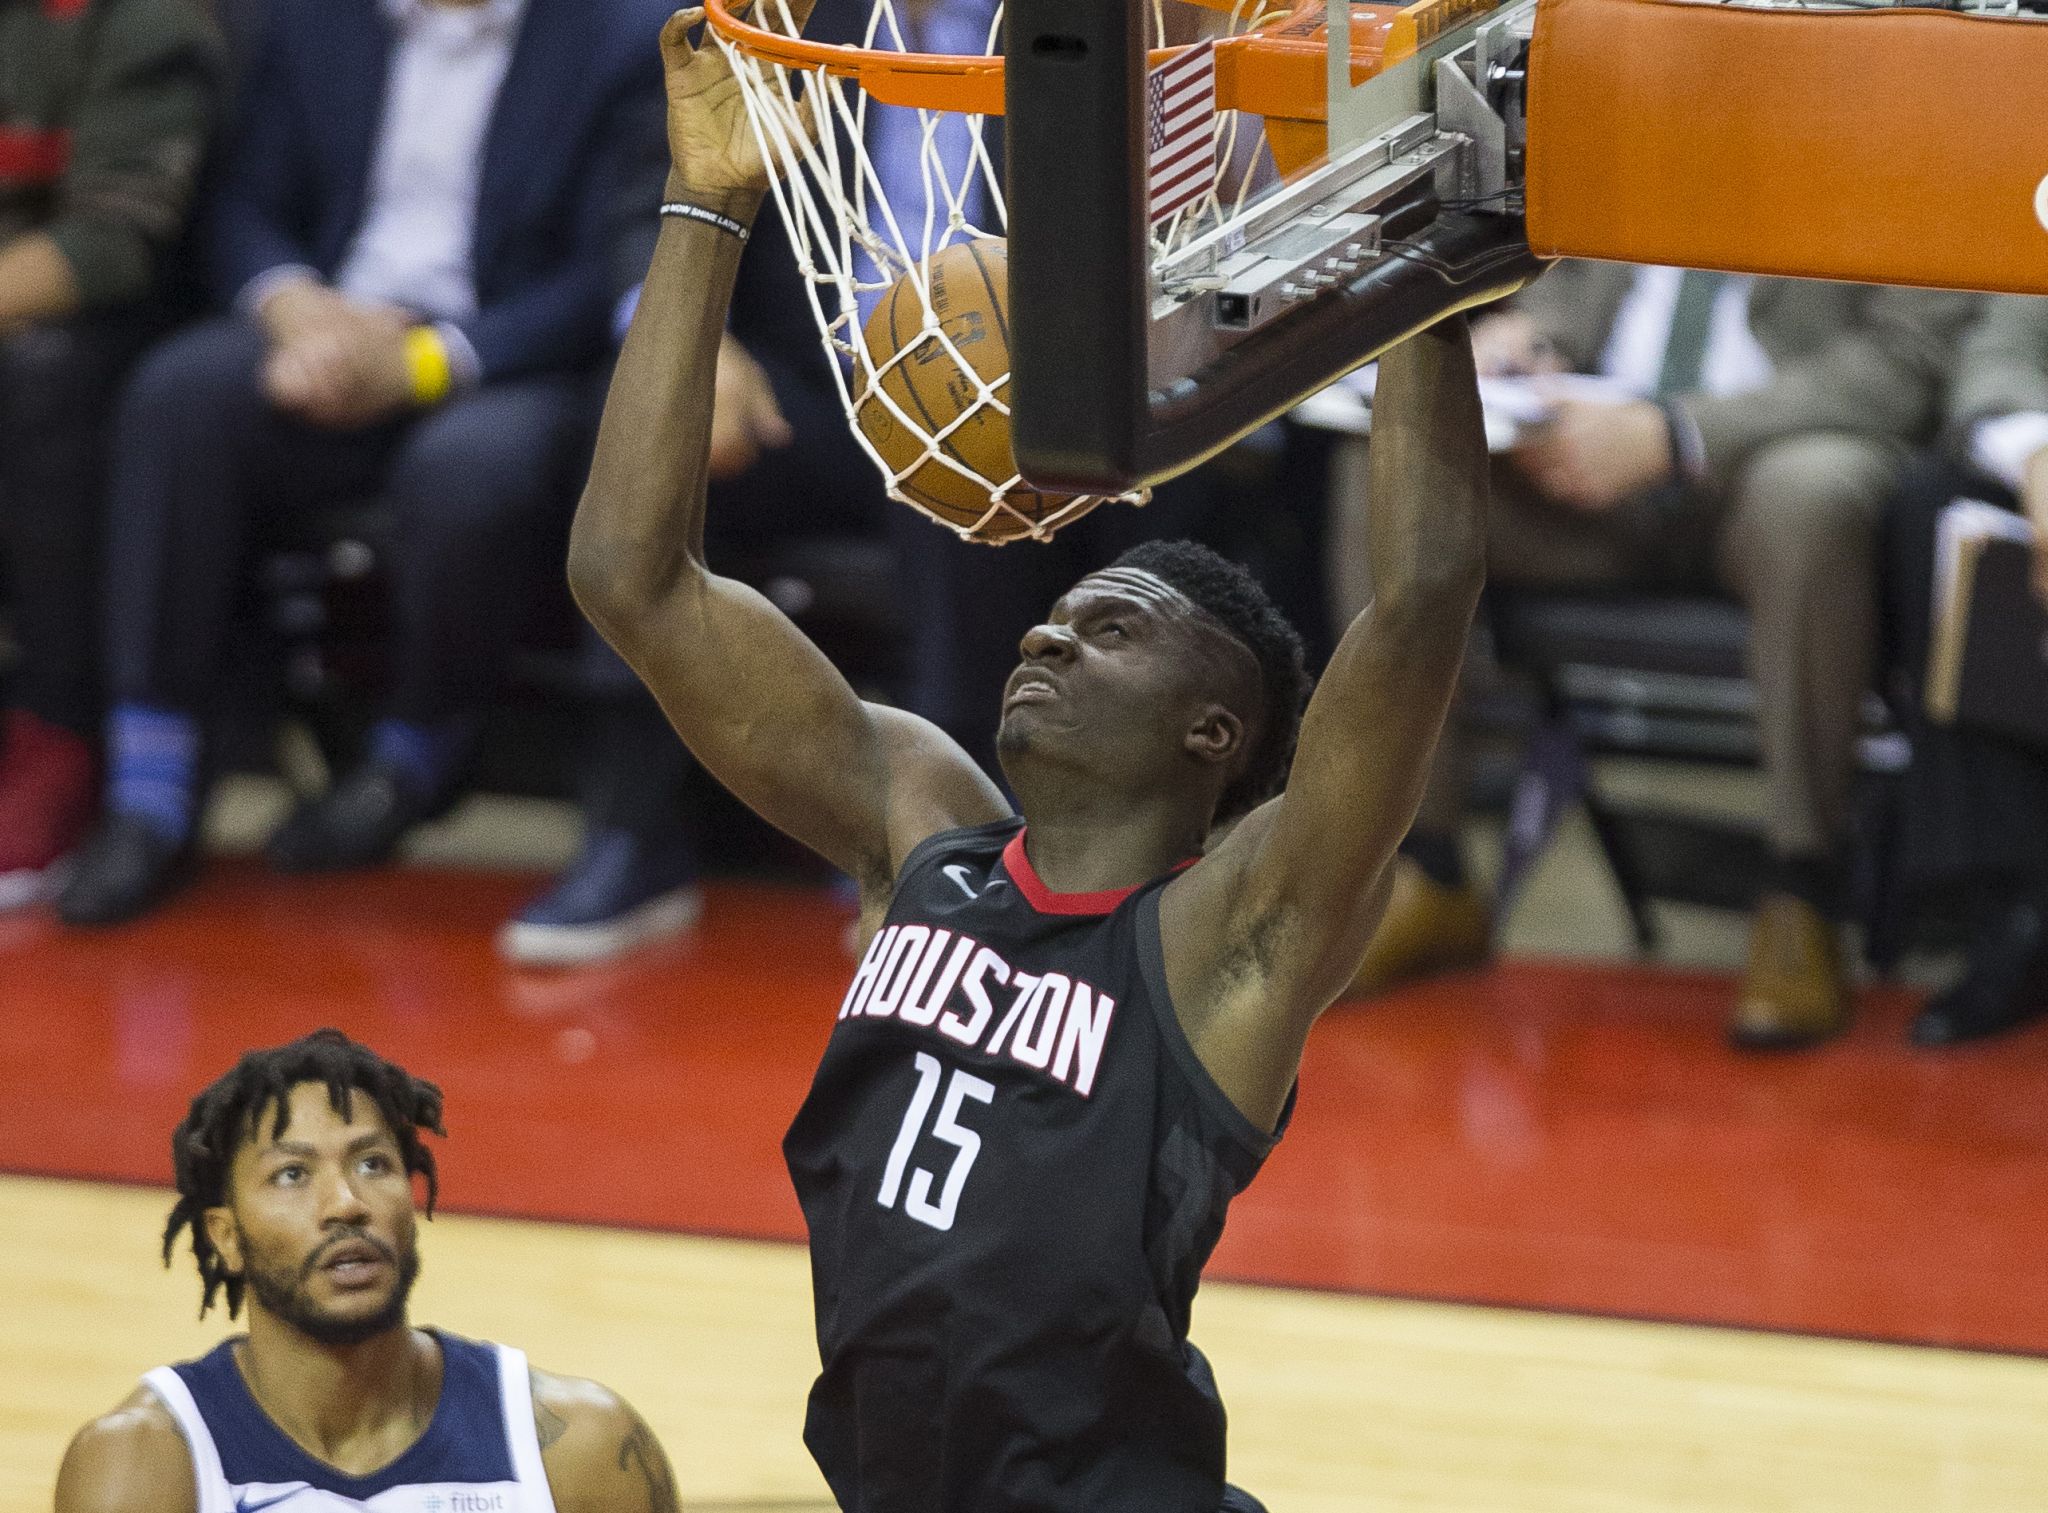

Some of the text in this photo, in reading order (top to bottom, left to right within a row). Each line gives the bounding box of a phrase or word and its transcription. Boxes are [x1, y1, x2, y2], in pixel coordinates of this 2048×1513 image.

[671, 203, 692, 214] NOW
[691, 207, 718, 222] SHINE
[717, 216, 740, 232] LATER
[838, 924, 1115, 1098] HOUSTON
[877, 1051, 995, 1232] 15
[449, 1491, 504, 1512] fitbit
